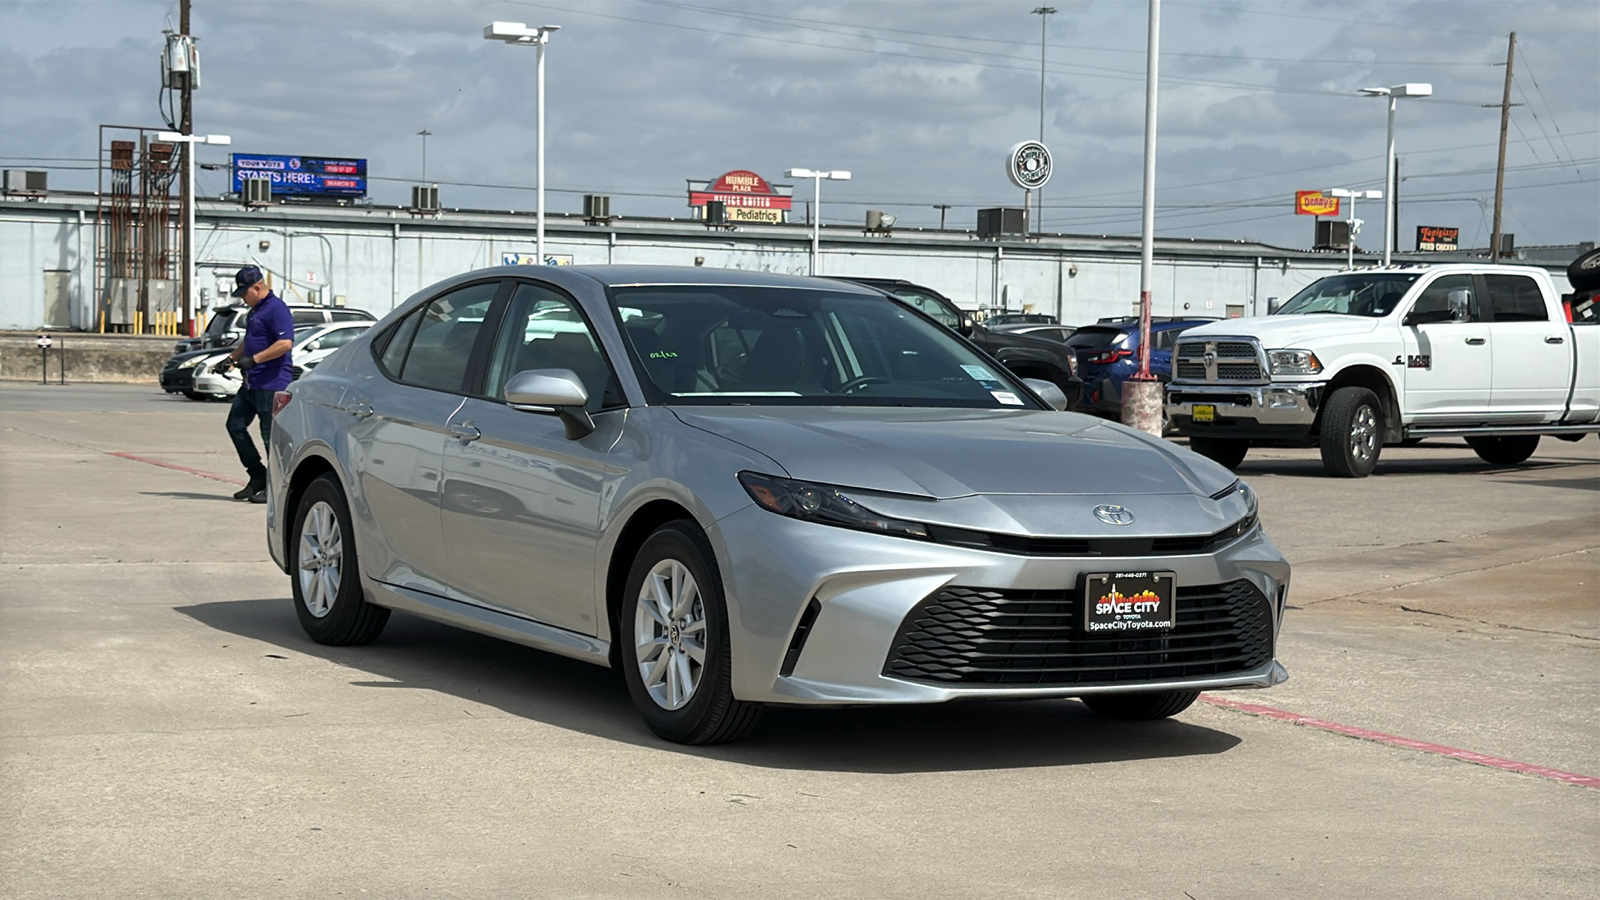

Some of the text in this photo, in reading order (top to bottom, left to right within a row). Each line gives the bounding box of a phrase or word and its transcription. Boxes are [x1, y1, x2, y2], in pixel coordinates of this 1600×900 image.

[238, 170, 315, 184] STARTS HERE!
[725, 176, 759, 186] HUMBLE
[742, 197, 771, 207] SUITES
[1304, 197, 1334, 208] Denny's
[736, 209, 777, 221] Pediatrics
[1096, 601, 1160, 614] SPACE CITY
[1089, 620, 1171, 631] SpaceCityToyota.com
